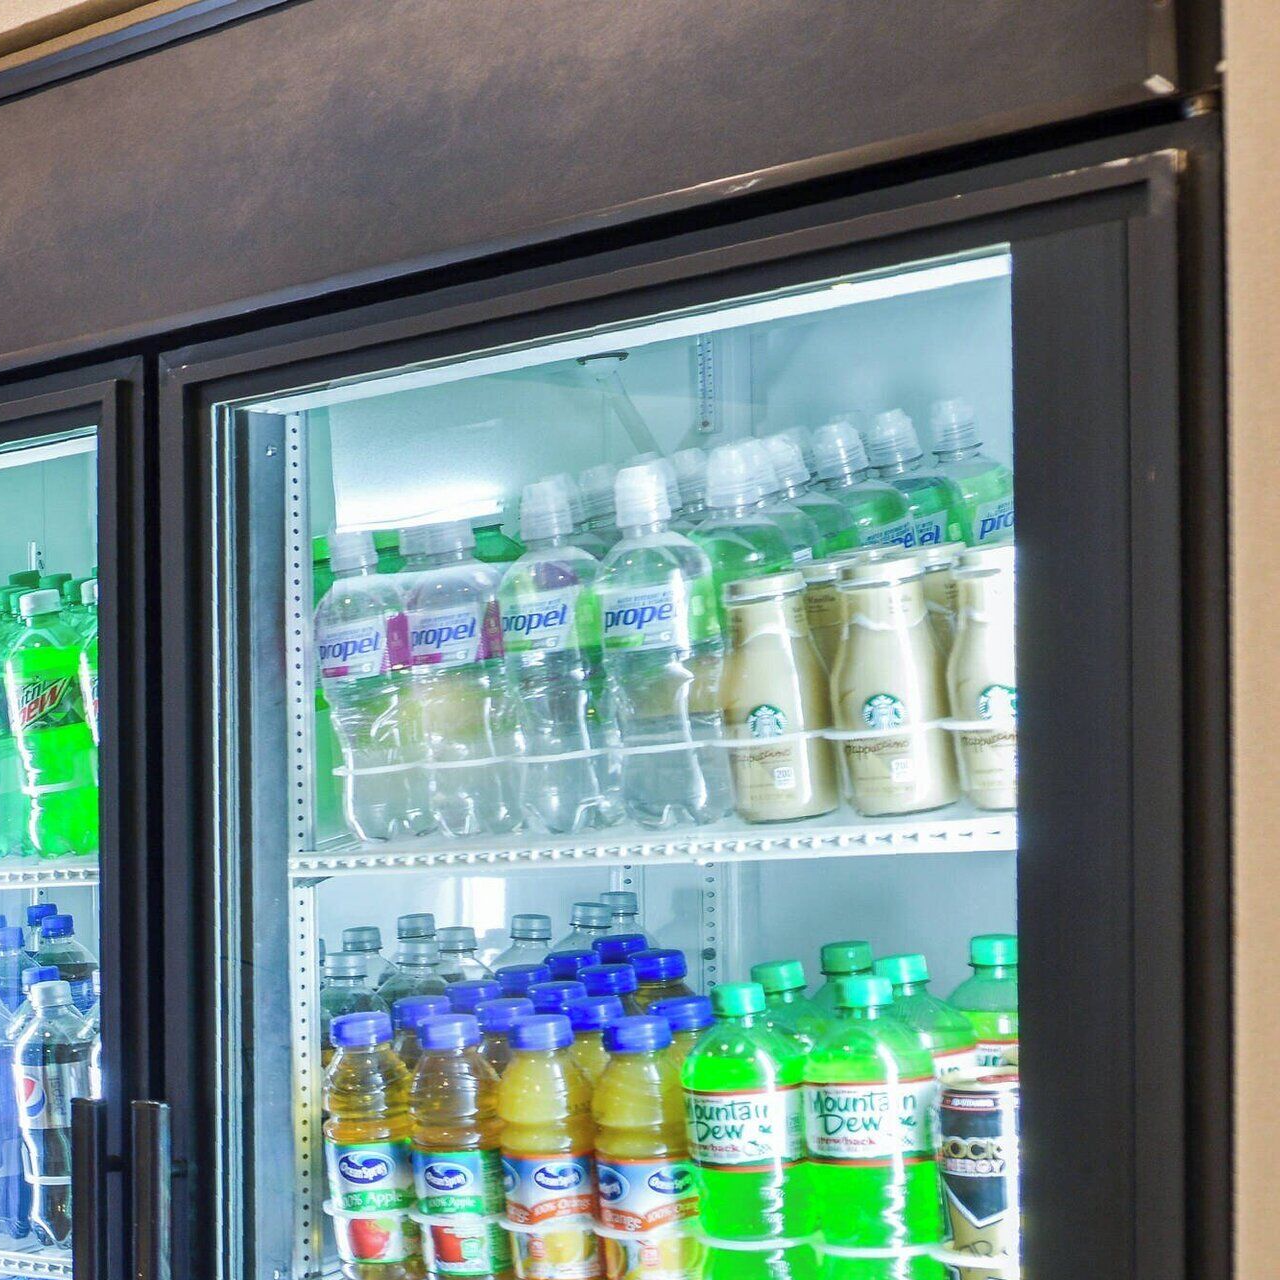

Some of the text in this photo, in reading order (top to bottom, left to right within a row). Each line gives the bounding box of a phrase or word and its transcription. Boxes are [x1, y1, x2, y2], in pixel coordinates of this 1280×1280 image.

[411, 616, 477, 649] propel
[501, 603, 568, 636] propel
[604, 602, 675, 633] prope
[319, 630, 382, 661] propel
[816, 1114, 883, 1136] Dew
[367, 1190, 402, 1208] Apple
